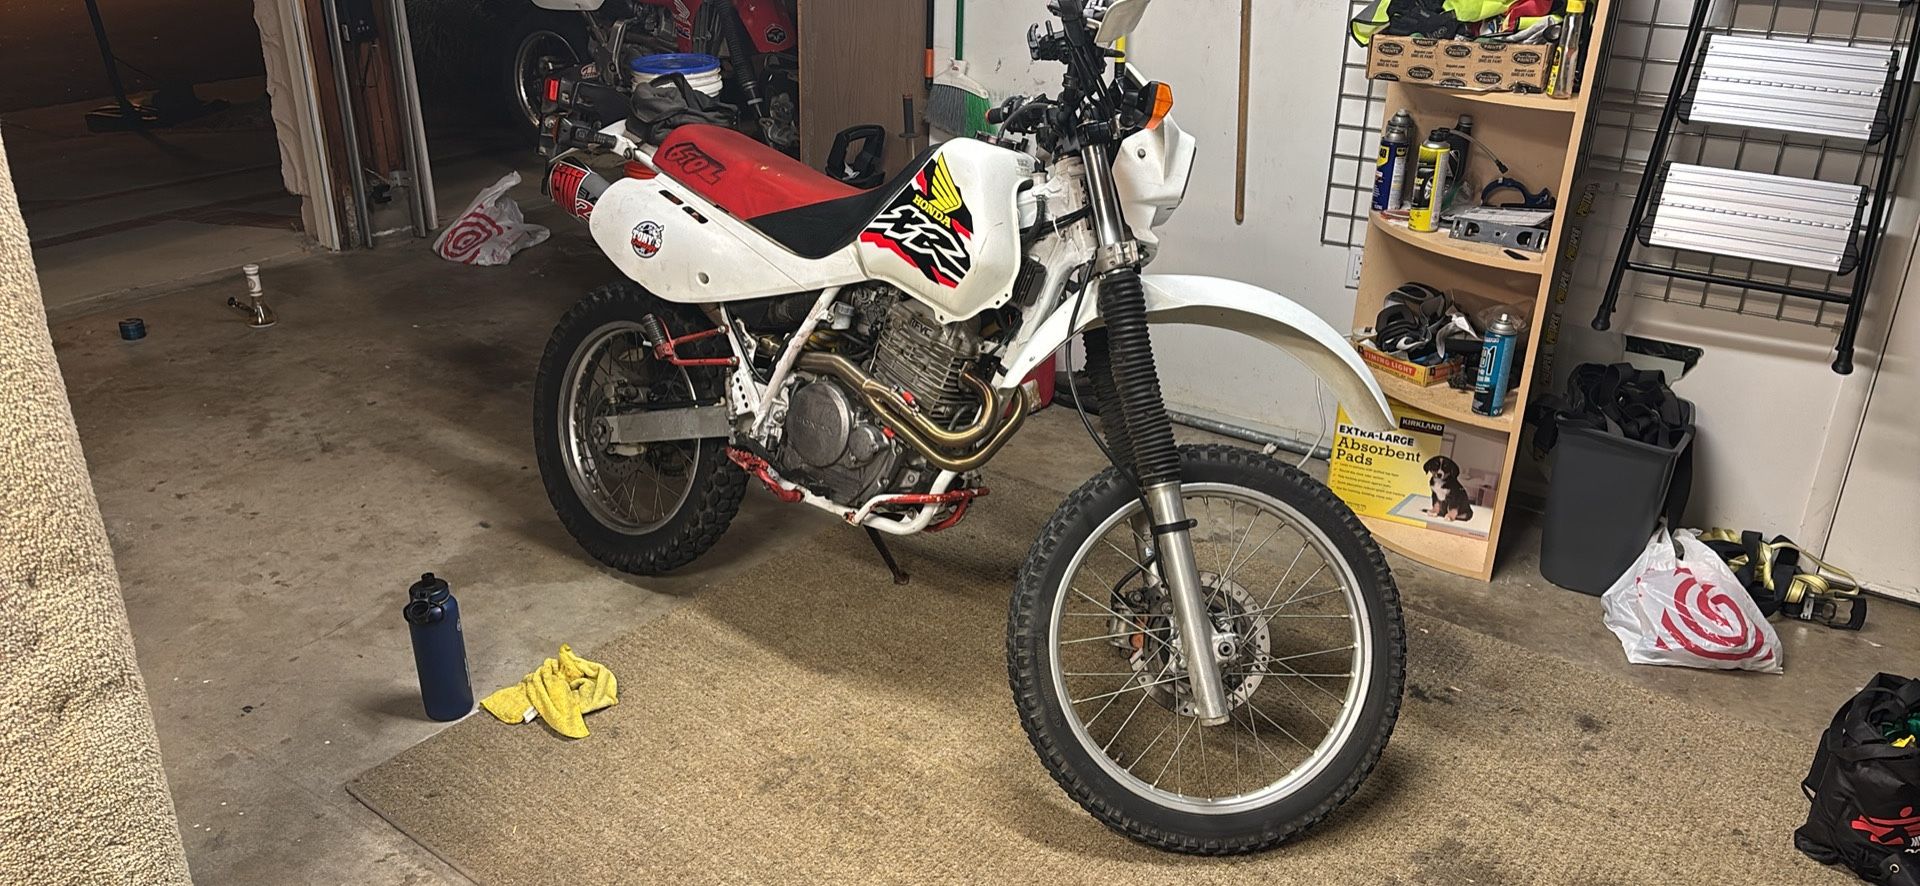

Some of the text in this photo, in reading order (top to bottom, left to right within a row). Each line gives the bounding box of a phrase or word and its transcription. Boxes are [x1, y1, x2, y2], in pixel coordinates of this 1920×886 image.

[912, 194, 951, 229] HONDA
[633, 229, 662, 248] TONY'S
[870, 204, 968, 280] XR
[1364, 350, 1390, 366] TIMING
[1391, 361, 1413, 375] LIGHT
[1339, 425, 1415, 447] EXTRA-LARGE
[1402, 418, 1443, 432] KIRKLAND
[1335, 448, 1373, 466] Pads
[1337, 437, 1421, 463] Absorbent
